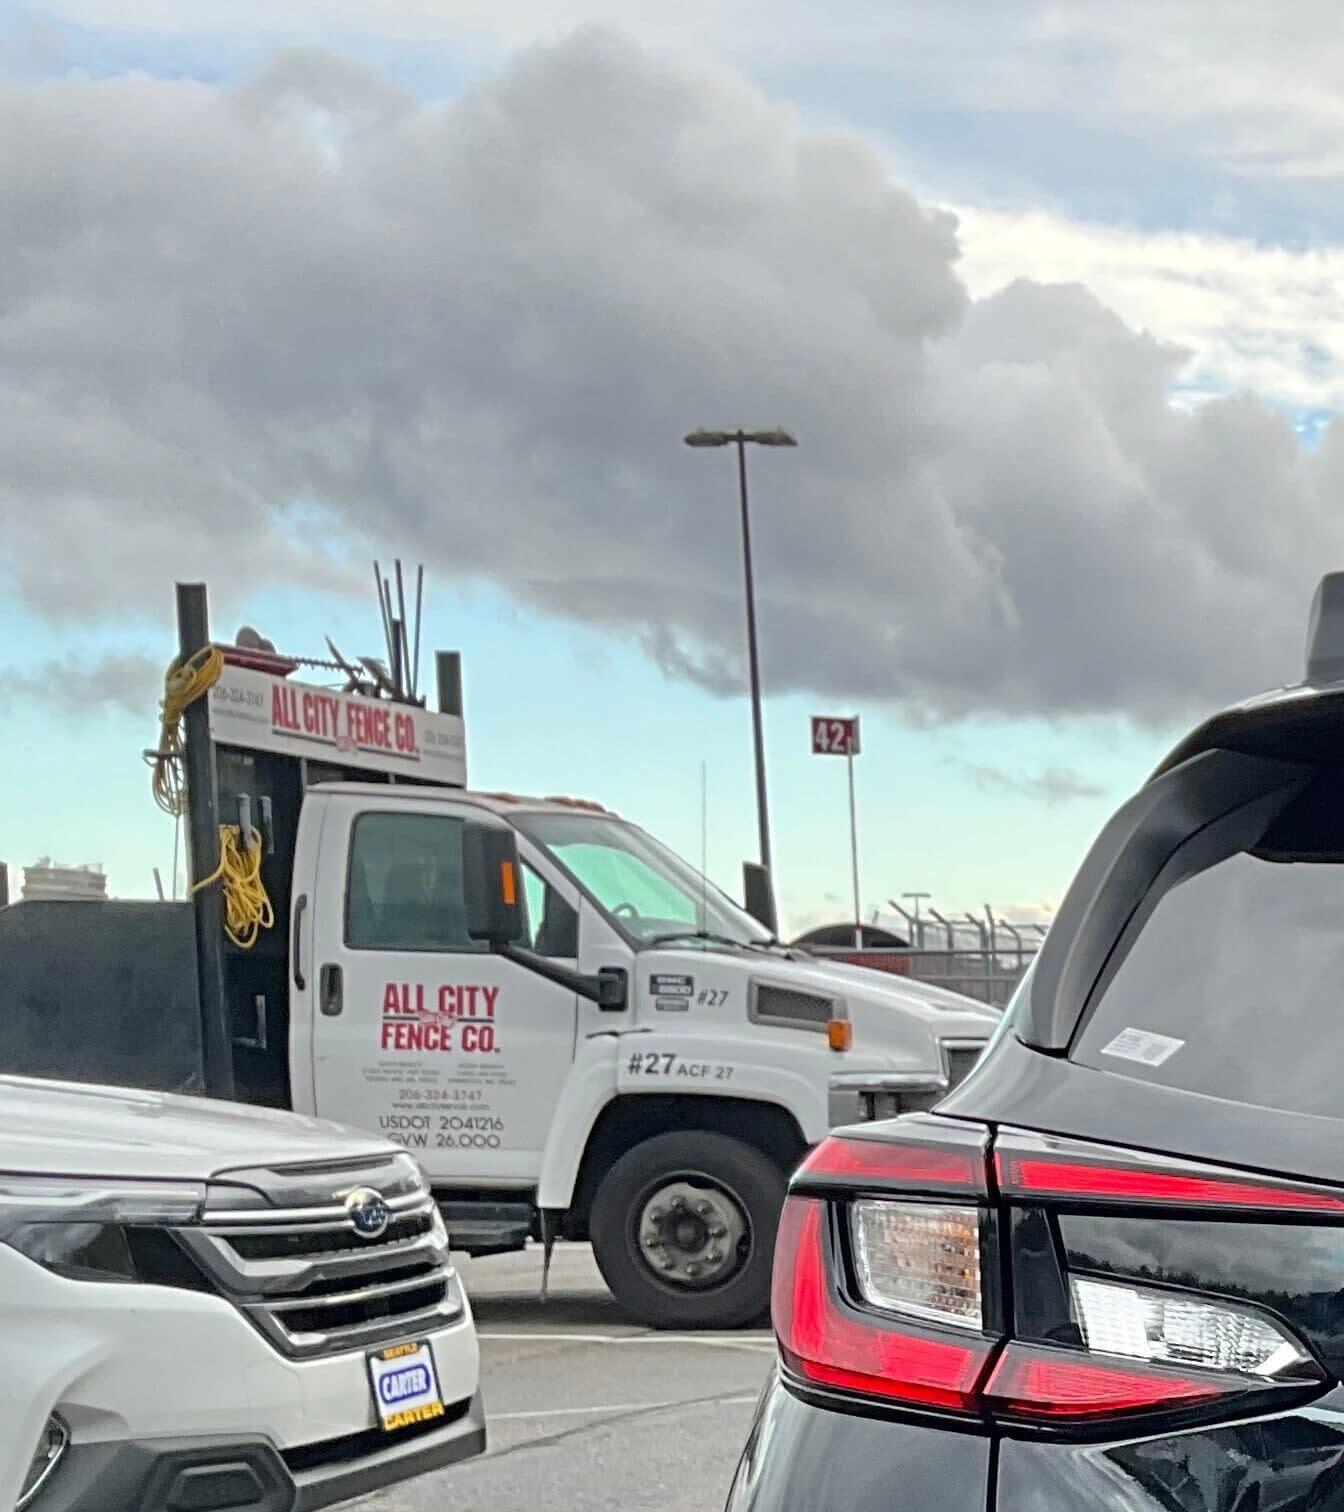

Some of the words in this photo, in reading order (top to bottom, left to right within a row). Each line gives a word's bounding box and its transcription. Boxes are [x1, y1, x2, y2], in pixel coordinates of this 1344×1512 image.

[271, 684, 300, 730] ALL
[302, 691, 340, 738] CITY
[345, 703, 391, 750] FENCE
[398, 713, 420, 755] CO.
[815, 721, 846, 752] 42
[383, 982, 424, 1014] ALL
[438, 984, 499, 1017] CITY
[697, 989, 729, 1007] #27
[381, 1023, 452, 1051] FENCE
[461, 1025, 501, 1053] CO.
[628, 1053, 677, 1075] #27
[677, 1063, 710, 1077] ACF
[715, 1066, 734, 1080] 27
[379, 1115, 431, 1130] USDOT
[440, 1116, 504, 1131] 2041216
[383, 1368, 427, 1400] CARTER
[384, 1402, 444, 1431] CARTER
